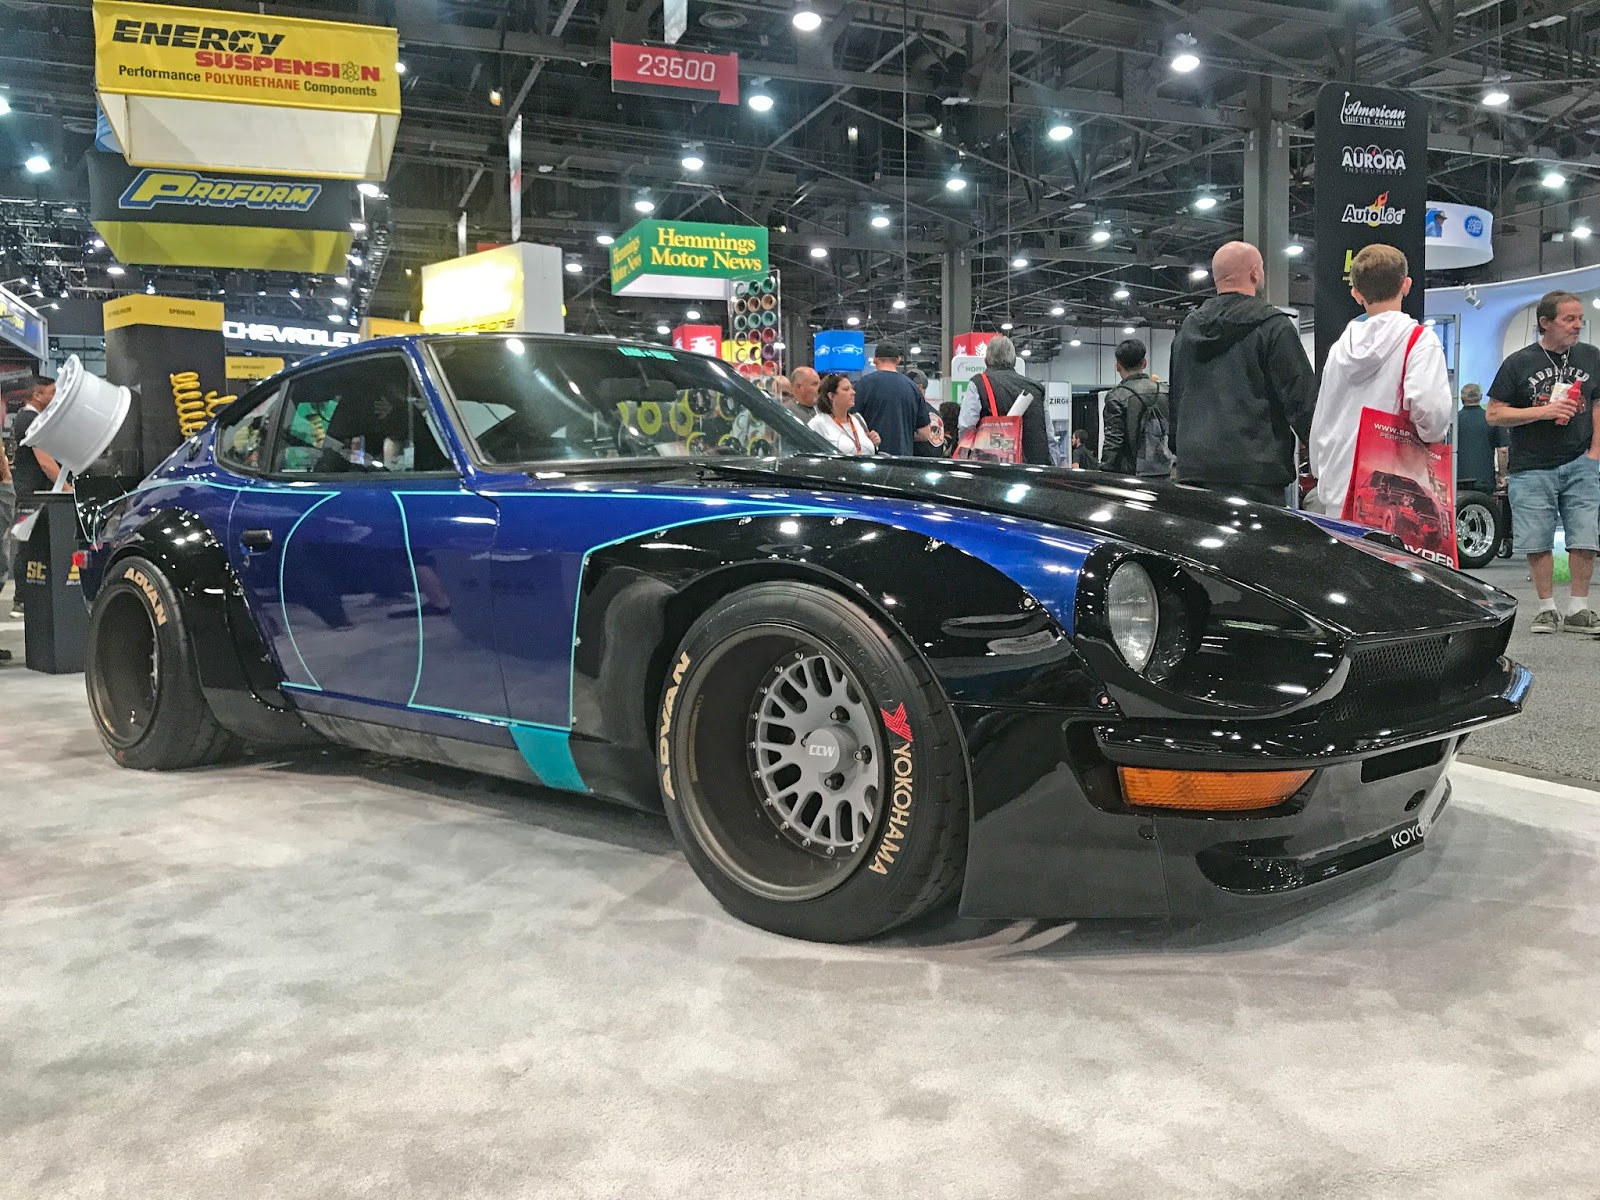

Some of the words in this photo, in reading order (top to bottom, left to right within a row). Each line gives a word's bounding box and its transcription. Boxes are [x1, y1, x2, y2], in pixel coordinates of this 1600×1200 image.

[112, 19, 286, 55] ENERGY
[118, 64, 201, 82] Performance
[205, 72, 300, 91] POLYURETHANE
[303, 81, 377, 97] Components
[637, 54, 716, 82] 23500
[1344, 100, 1406, 120] American
[1344, 115, 1371, 125] SHIFTER
[1374, 118, 1406, 127] COMPANY
[1341, 152, 1406, 170] AURORA
[119, 168, 322, 212] PROFORM
[657, 227, 756, 255] Hemmings
[651, 247, 708, 268] Motor
[713, 251, 762, 271] News
[222, 321, 360, 347] CHEVROLET
[123, 566, 167, 627] ADVAN
[659, 650, 691, 801] ADVAN
[808, 744, 835, 757] CCW
[868, 742, 914, 876] YOKOHAMA
